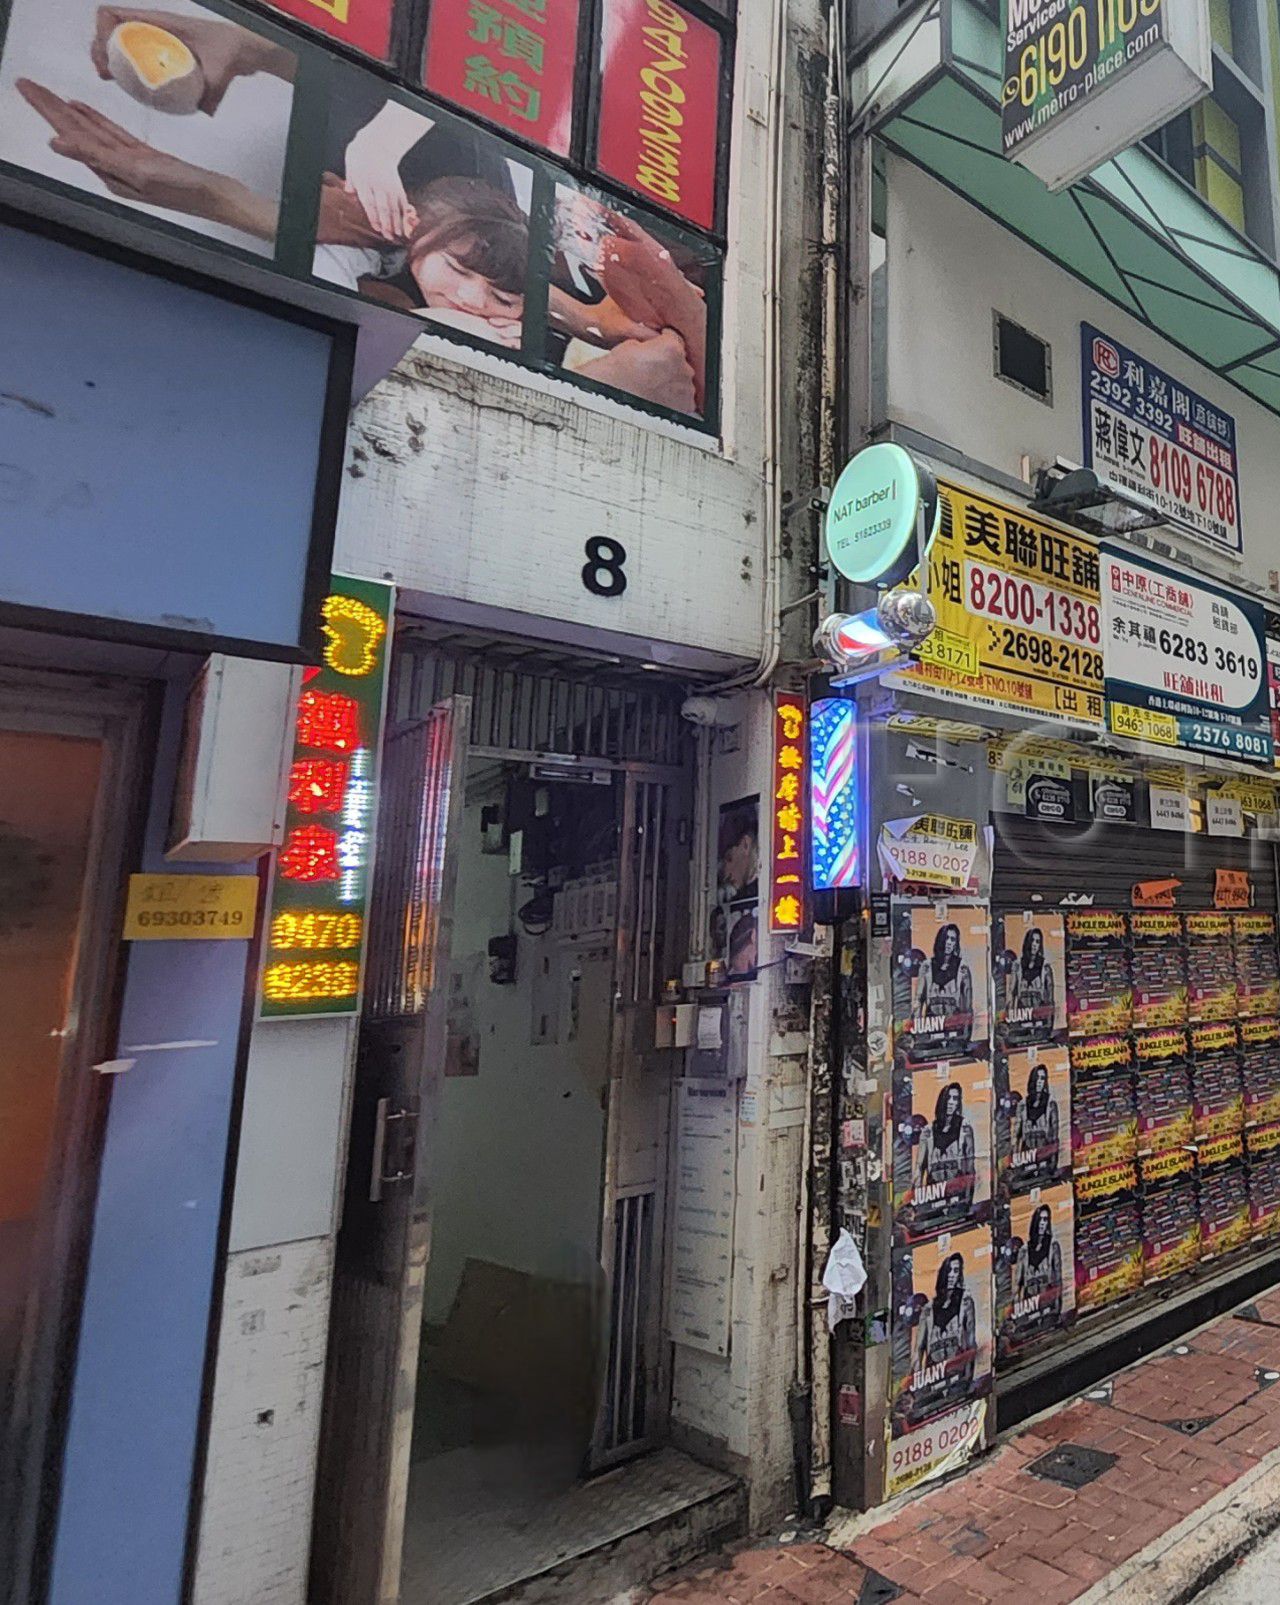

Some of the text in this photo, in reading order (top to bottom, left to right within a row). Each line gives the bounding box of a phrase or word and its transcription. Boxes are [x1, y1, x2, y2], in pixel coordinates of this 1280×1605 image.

[1020, 6, 1087, 107] 6190
[1004, 23, 1159, 148] www.metro-place.com
[1090, 371, 1173, 432] 2392 3392
[1150, 435, 1191, 503] 8109
[1197, 462, 1235, 526] 6788
[834, 486, 891, 524] NAT barber
[582, 536, 628, 597] 8
[970, 567, 1100, 644] 8200-1338
[936, 643, 971, 668] 8171
[1003, 628, 1104, 680] 2698-2128
[1160, 630, 1208, 666] 6283
[1215, 647, 1259, 680] 3619
[1117, 714, 1172, 739] 9463 1068
[1193, 724, 1230, 748] 2576
[1236, 733, 1269, 755] 8081
[890, 847, 970, 873] 9188 0202
[910, 1015, 946, 1034] JUANY
[1006, 1008, 1033, 1023] JUANY
[1011, 1150, 1037, 1167] JUANY
[911, 1182, 947, 1206] JUANY
[1012, 1296, 1039, 1319] JUANY
[910, 1360, 948, 1391] JUANY
[893, 1437, 933, 1472] 9188
